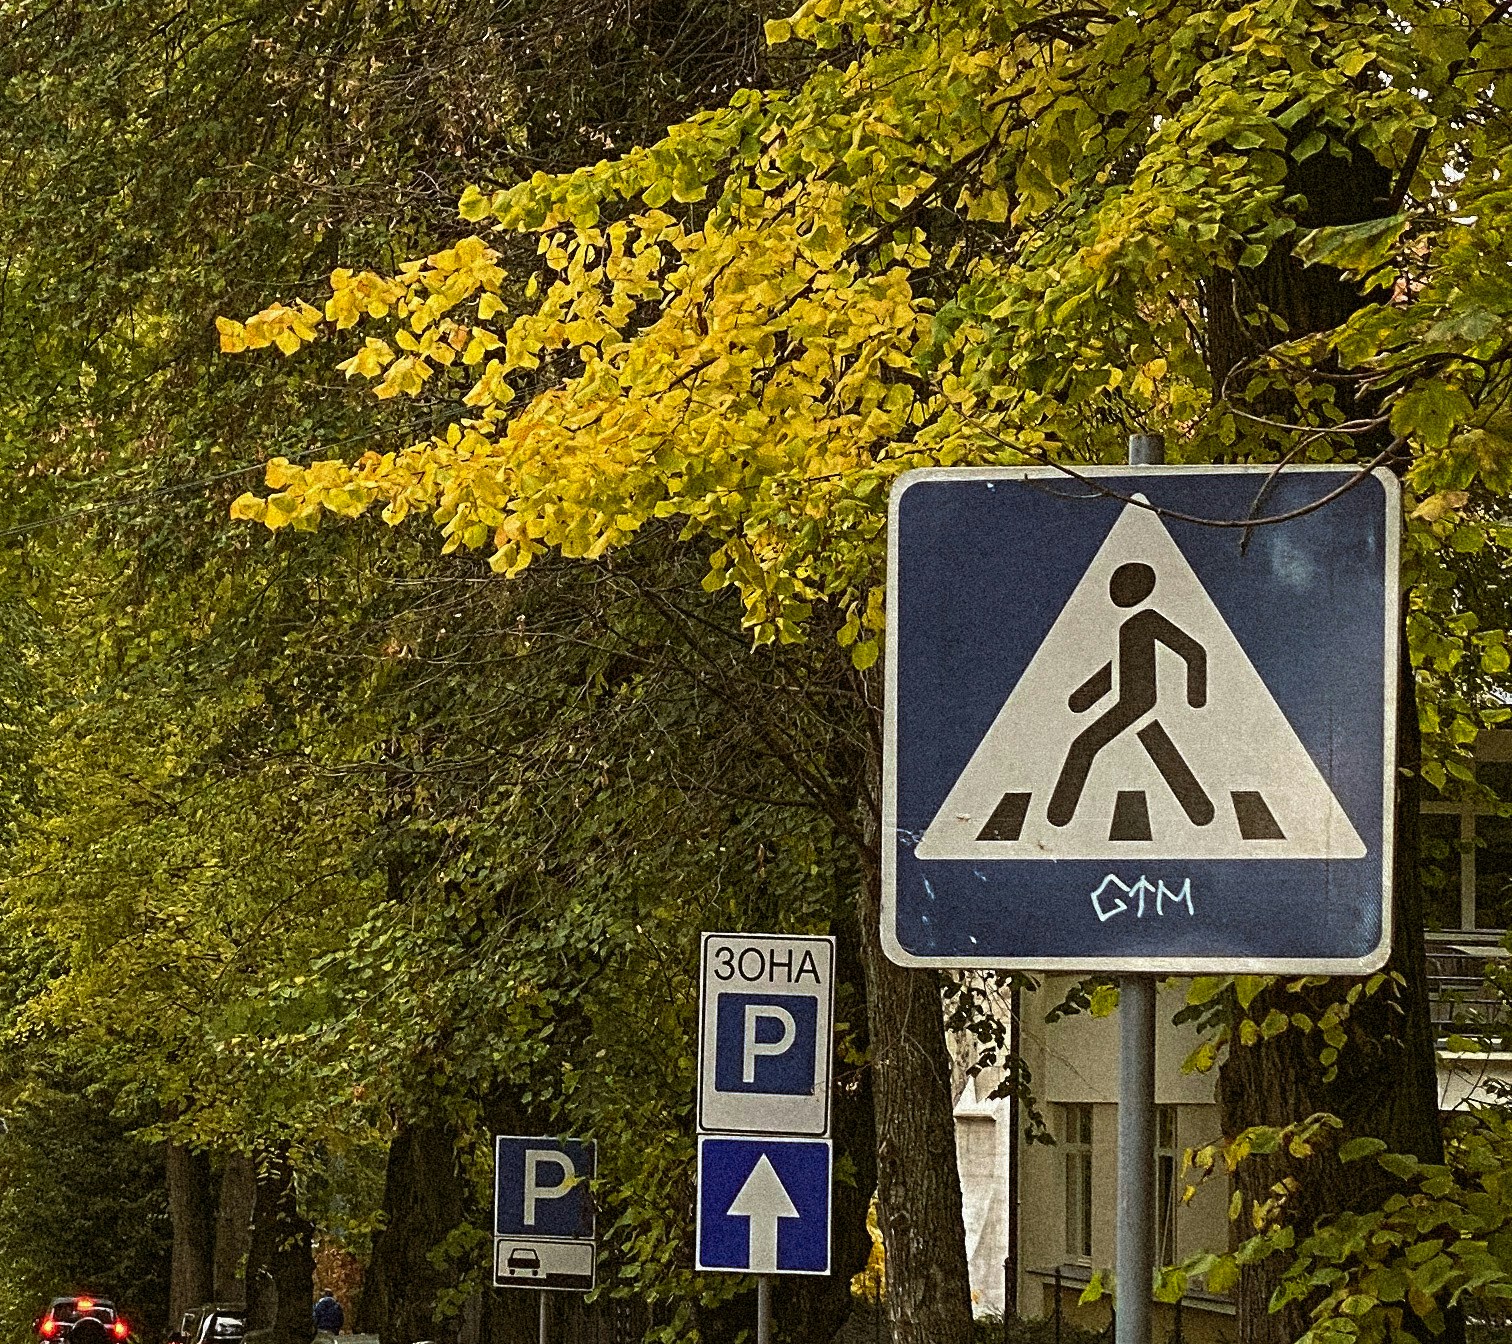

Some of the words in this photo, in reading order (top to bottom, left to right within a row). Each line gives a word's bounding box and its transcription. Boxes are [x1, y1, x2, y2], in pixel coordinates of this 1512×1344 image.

[713, 946, 821, 984] ЗОНА
[742, 1004, 796, 1083] P
[523, 1149, 576, 1226] P
